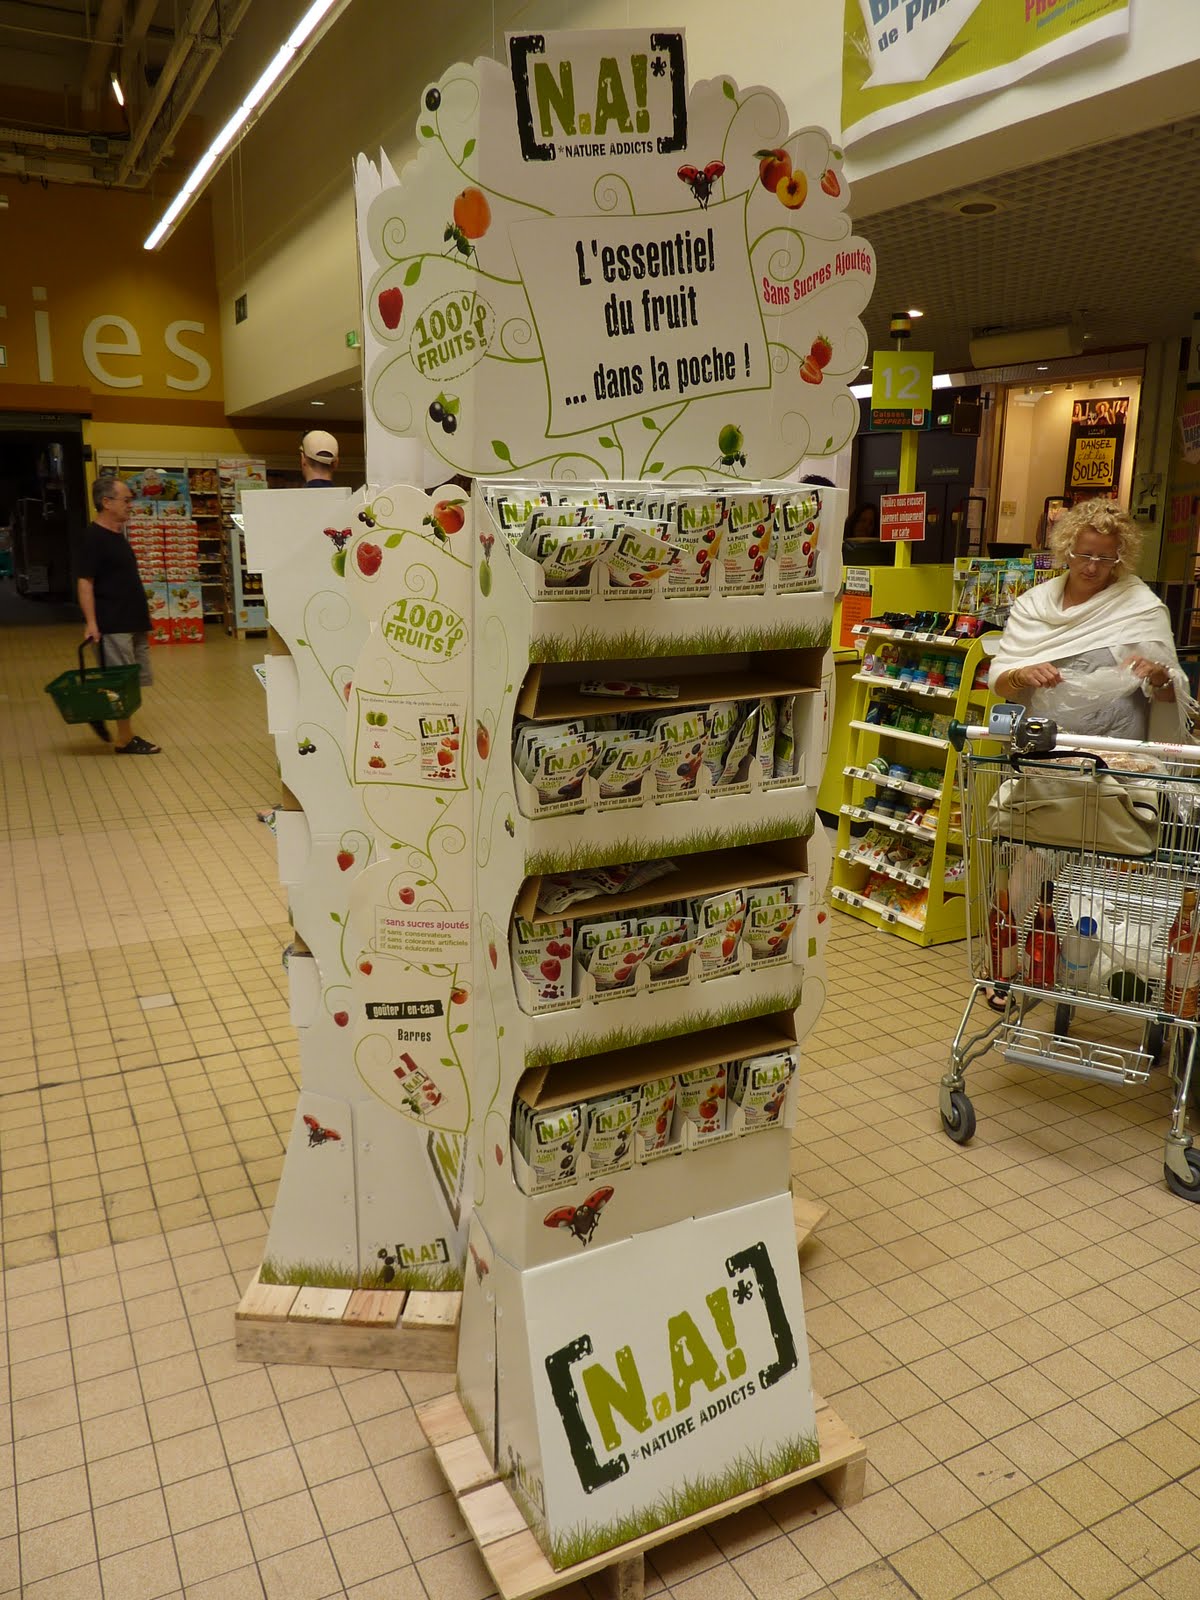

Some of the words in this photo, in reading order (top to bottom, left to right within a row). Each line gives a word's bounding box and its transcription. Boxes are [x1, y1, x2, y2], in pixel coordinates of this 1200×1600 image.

[878, 28, 899, 52] de
[563, 143, 606, 158] NATURE
[609, 141, 653, 156] ADDICTS
[575, 228, 716, 287] L'essentiel
[762, 275, 791, 306] Sans
[793, 264, 832, 303] Sucres
[834, 248, 872, 277] Ajoutés
[416, 290, 487, 349] 100%
[604, 295, 633, 338] du
[642, 285, 699, 332] fruit
[0, 286, 212, 391] ies
[417, 319, 487, 375] FRUITS!
[594, 363, 643, 401] dans
[650, 358, 671, 392] la
[677, 346, 737, 393] poche
[882, 365, 921, 400] 12
[1080, 439, 1112, 450] DANSEZ
[1073, 459, 1114, 482] SOLDES!
[393, 599, 463, 640] 100%
[385, 622, 457, 657] FRUITS!
[386, 919, 405, 927] sans
[407, 920, 434, 929] sucres
[437, 921, 469, 931] ajoutés
[405, 931, 451, 939] conservateurs
[373, 1004, 399, 1017] goûter
[407, 1004, 435, 1015] en-cas
[397, 1028, 431, 1042] Barres
[640, 1417, 696, 1460] NATURE
[700, 1381, 756, 1427] ADDICTS
